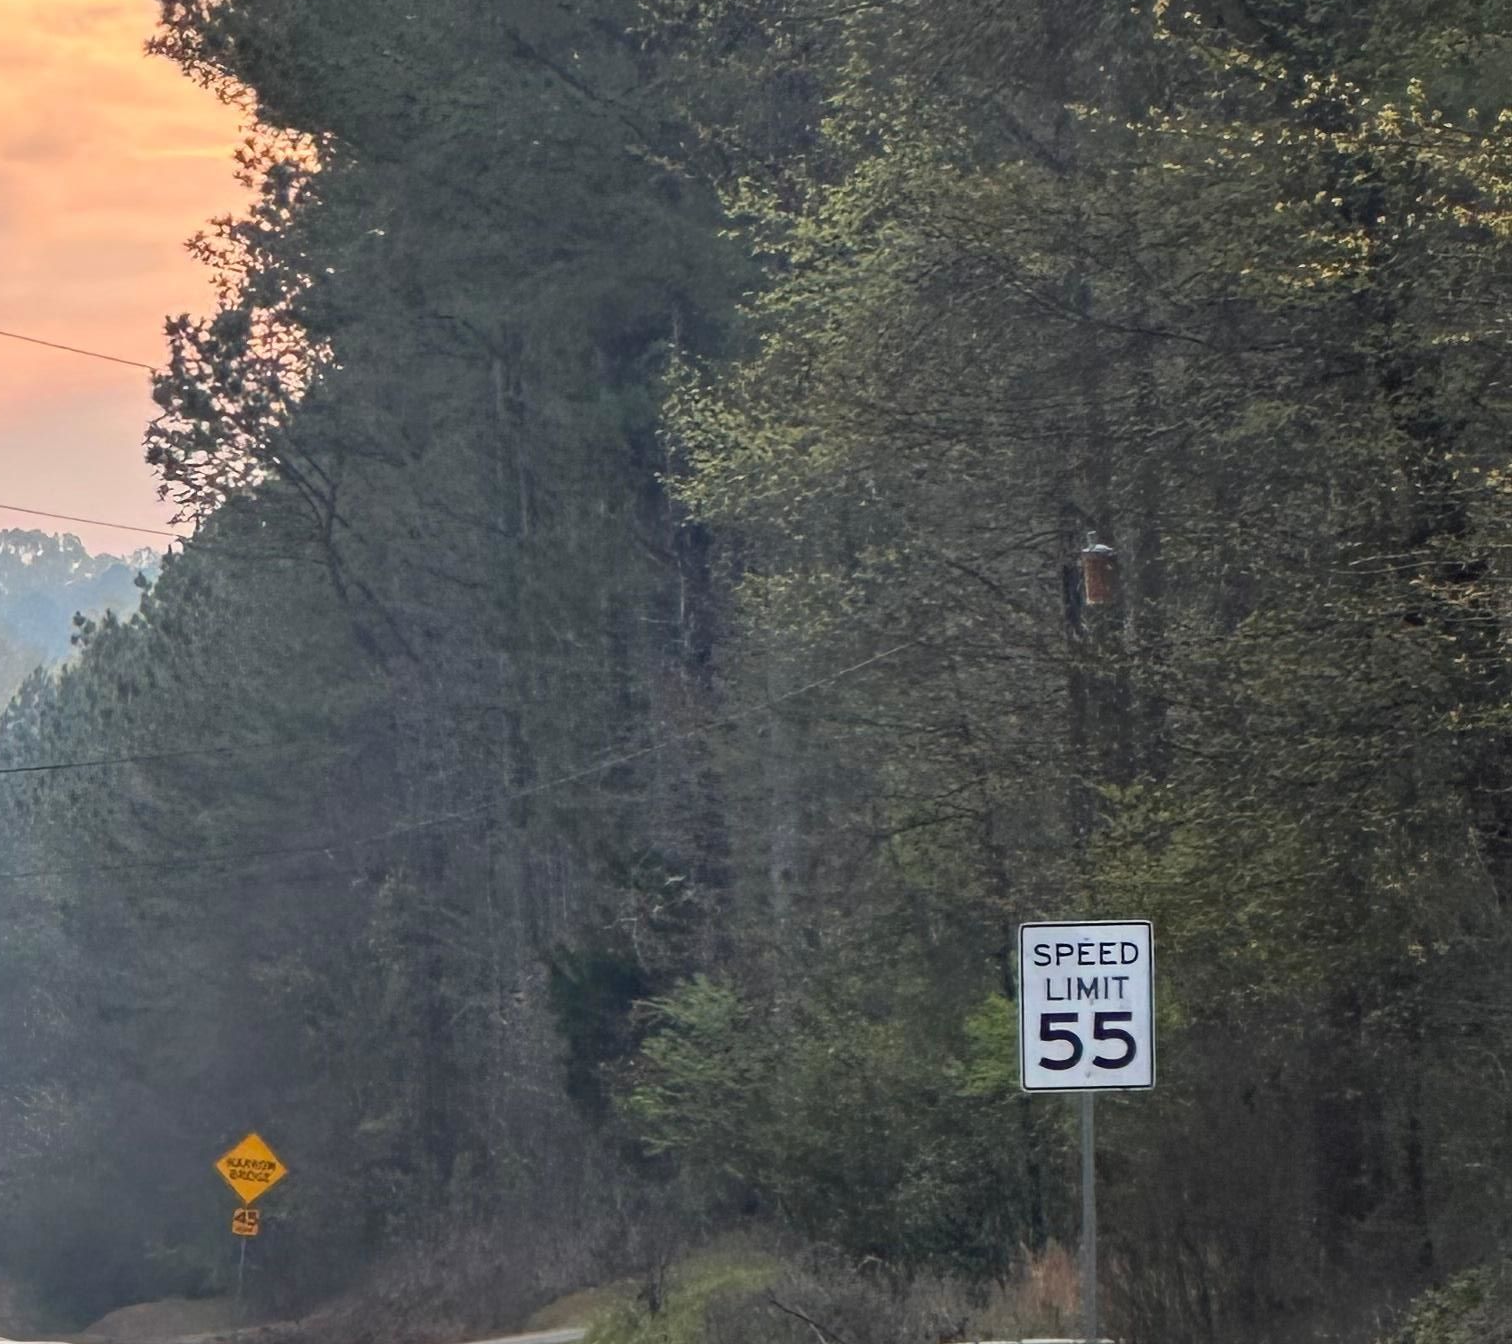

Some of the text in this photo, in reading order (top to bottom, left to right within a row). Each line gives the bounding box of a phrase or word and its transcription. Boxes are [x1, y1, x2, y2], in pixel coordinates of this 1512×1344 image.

[1033, 941, 1139, 967] SPEED
[1046, 976, 1130, 1001] LIMIT
[1038, 1011, 1137, 1071] 55
[234, 1211, 257, 1226] 45
